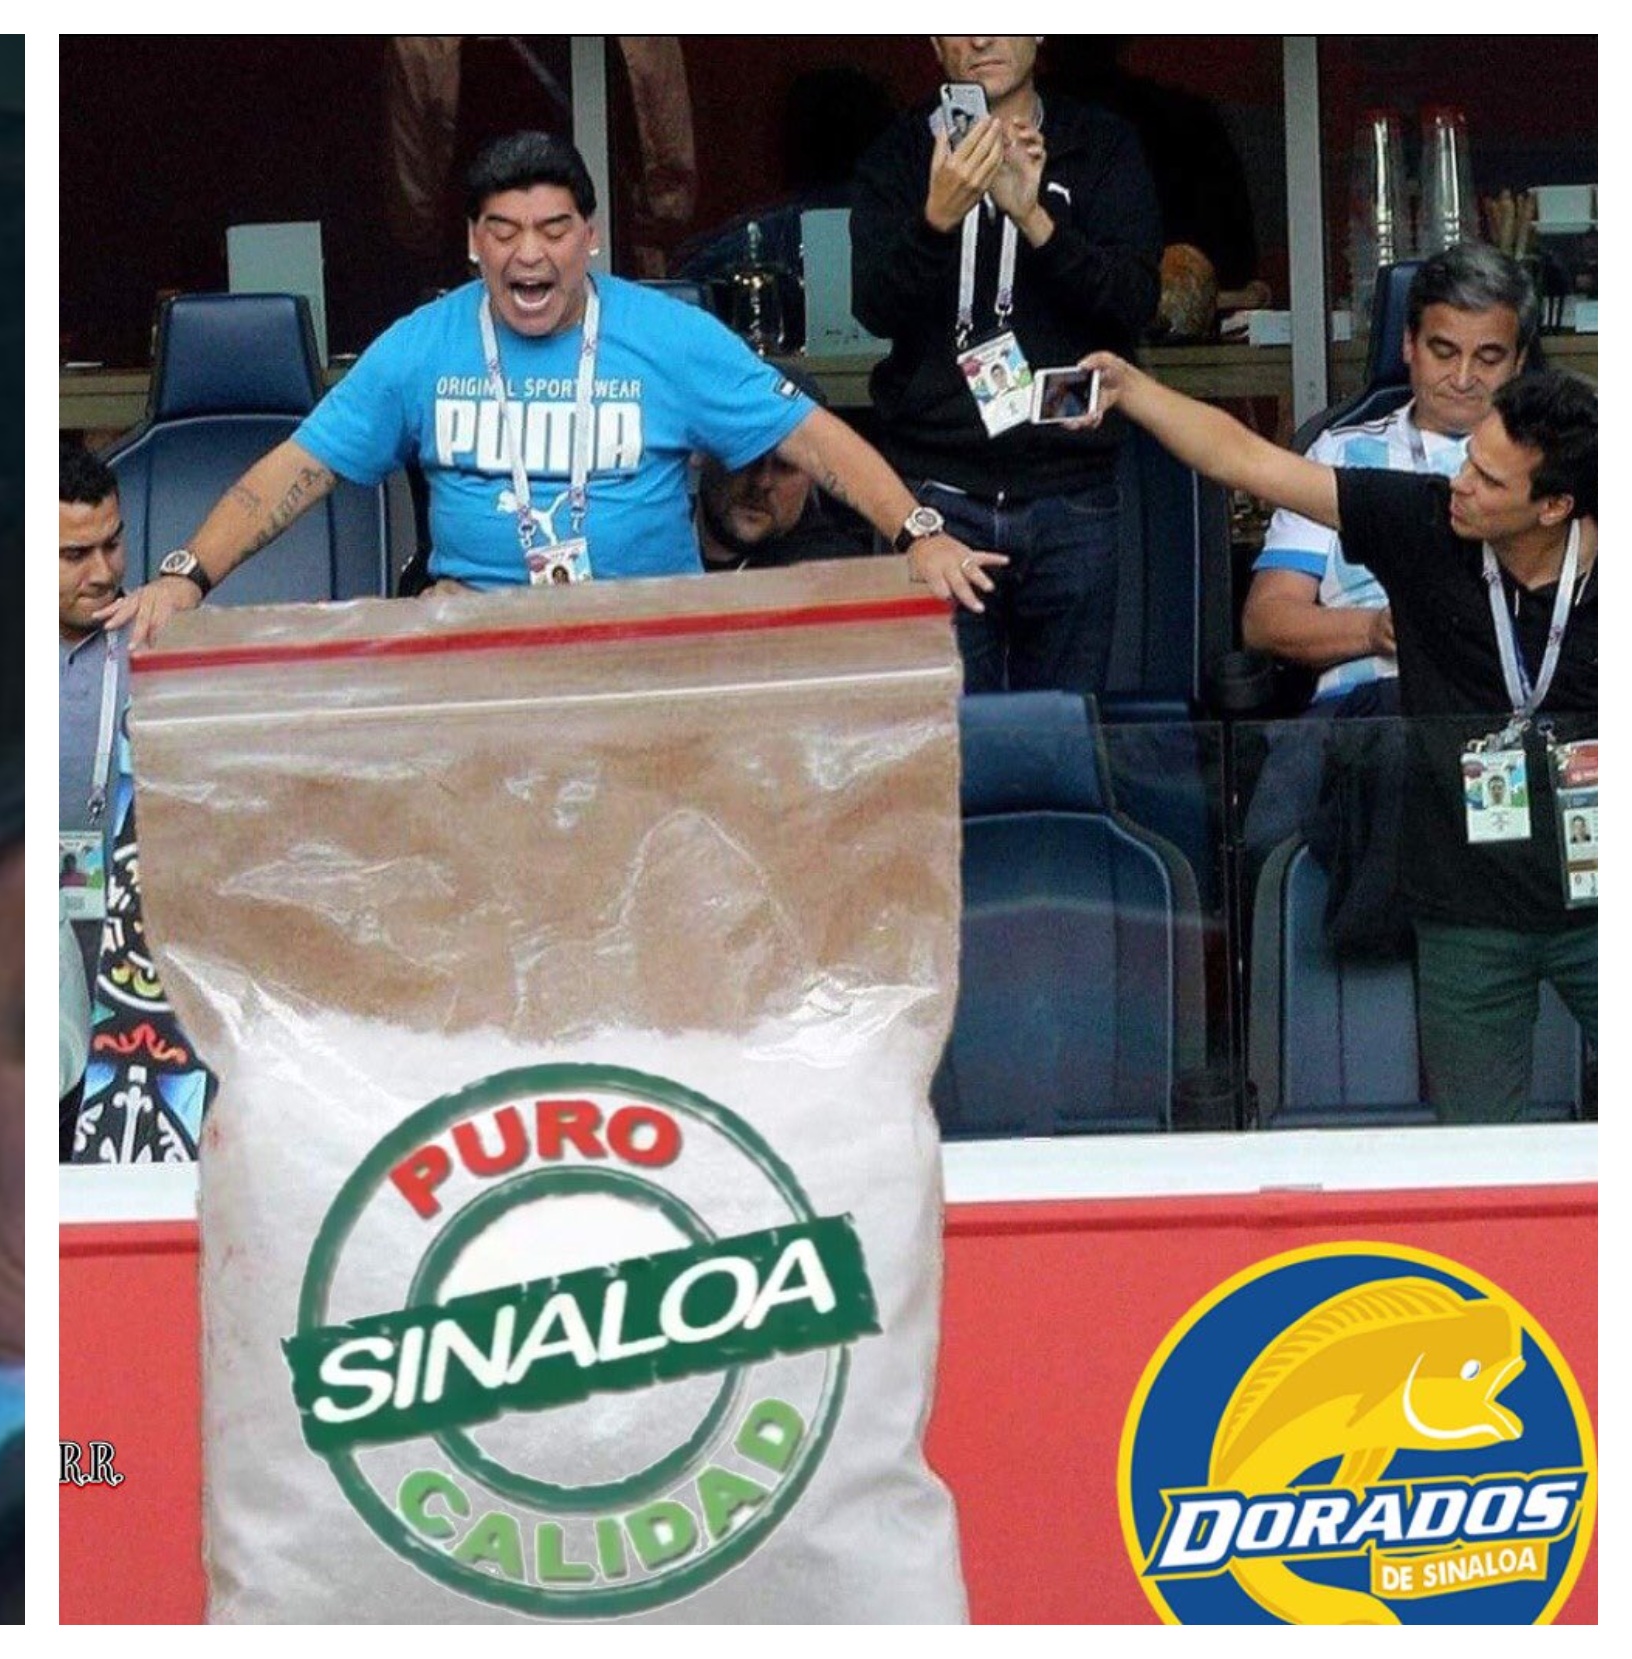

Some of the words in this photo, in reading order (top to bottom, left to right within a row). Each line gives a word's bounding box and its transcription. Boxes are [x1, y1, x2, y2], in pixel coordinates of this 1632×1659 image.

[435, 399, 642, 472] PUMA
[436, 375, 516, 397] ORIGINL
[524, 377, 641, 399] SPORWEAR
[389, 1099, 682, 1221] PURO
[312, 1238, 837, 1423] SINALOA
[396, 1398, 807, 1584] CALIDAD
